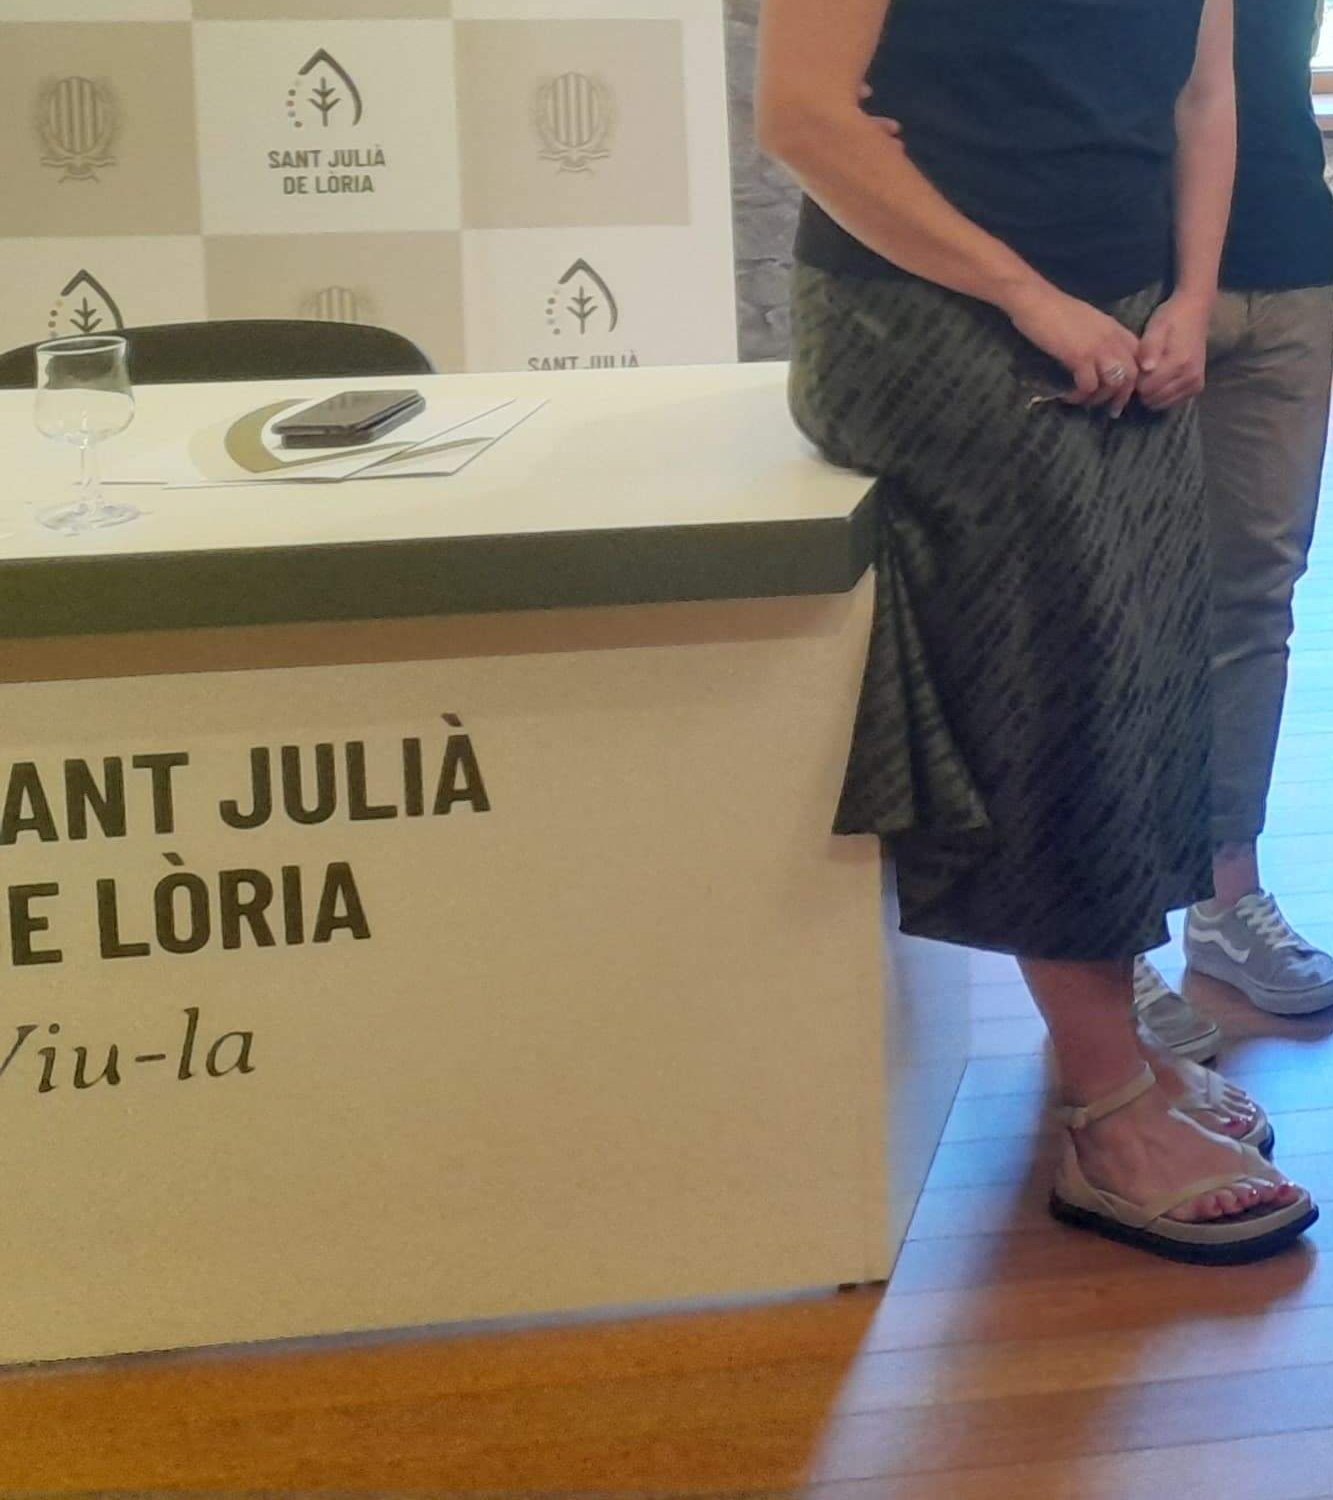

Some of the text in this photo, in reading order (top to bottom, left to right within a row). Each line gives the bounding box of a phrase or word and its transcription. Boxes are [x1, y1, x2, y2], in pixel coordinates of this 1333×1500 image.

[267, 143, 386, 169] SANT JULIÀ
[283, 170, 375, 195] DE LÒRIA
[219, 712, 492, 830] JULIÀ
[96, 851, 372, 960] LÒRIA
